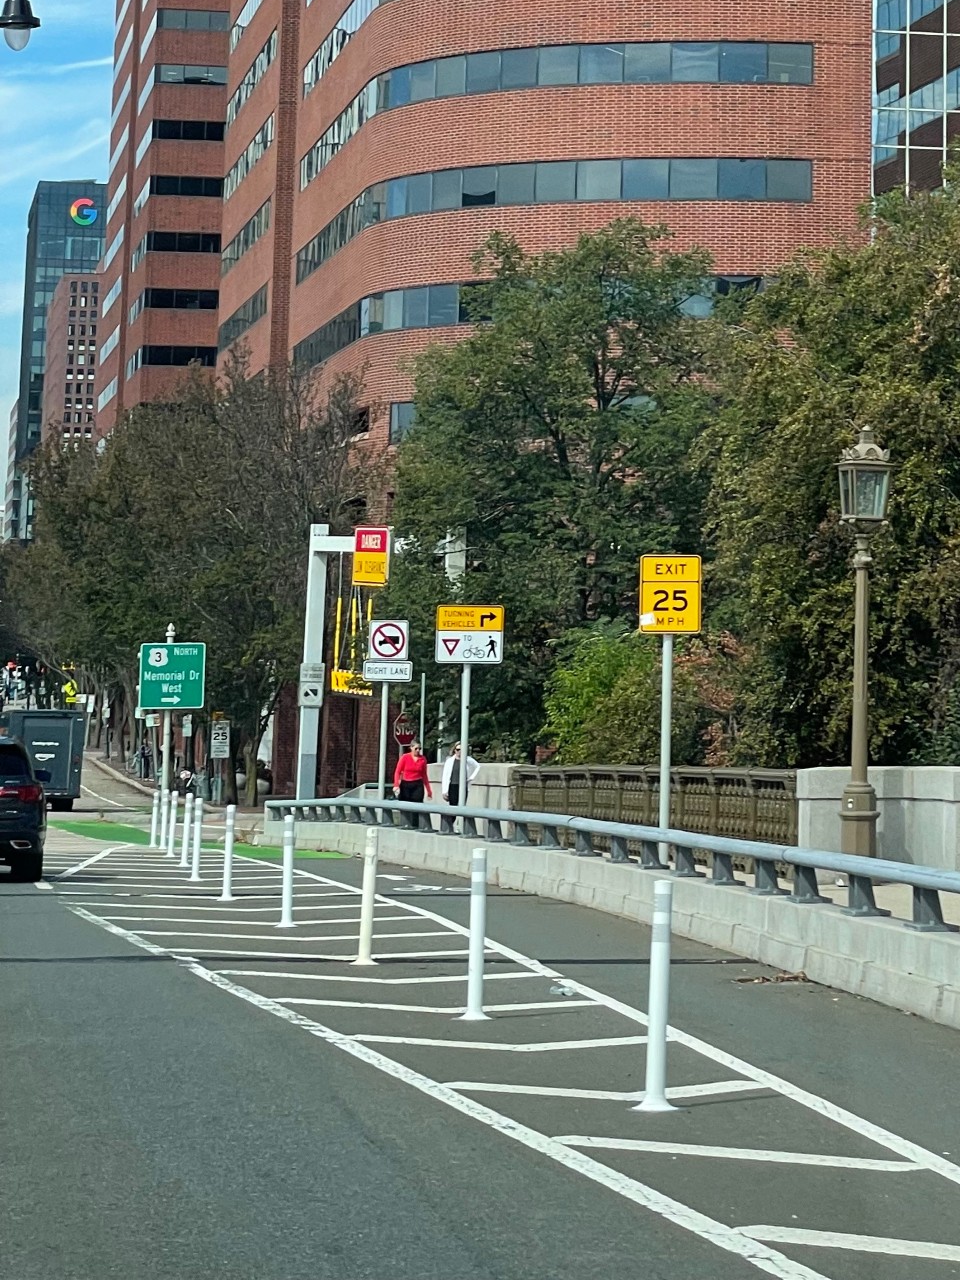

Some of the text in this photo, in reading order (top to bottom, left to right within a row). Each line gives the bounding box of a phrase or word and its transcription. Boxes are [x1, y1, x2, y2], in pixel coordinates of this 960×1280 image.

[71, 198, 97, 225] G
[655, 563, 687, 575] EXIT
[653, 589, 688, 612] 25
[444, 610, 475, 618] TURNING
[442, 620, 476, 628] VEHICLES
[656, 617, 685, 626] MPH
[463, 634, 472, 642] TO
[155, 651, 162, 663] 3
[143, 669, 200, 681] Memorial Dr
[367, 666, 408, 676] RIGHT LANE
[161, 683, 182, 693] West
[213, 731, 228, 741] 25
